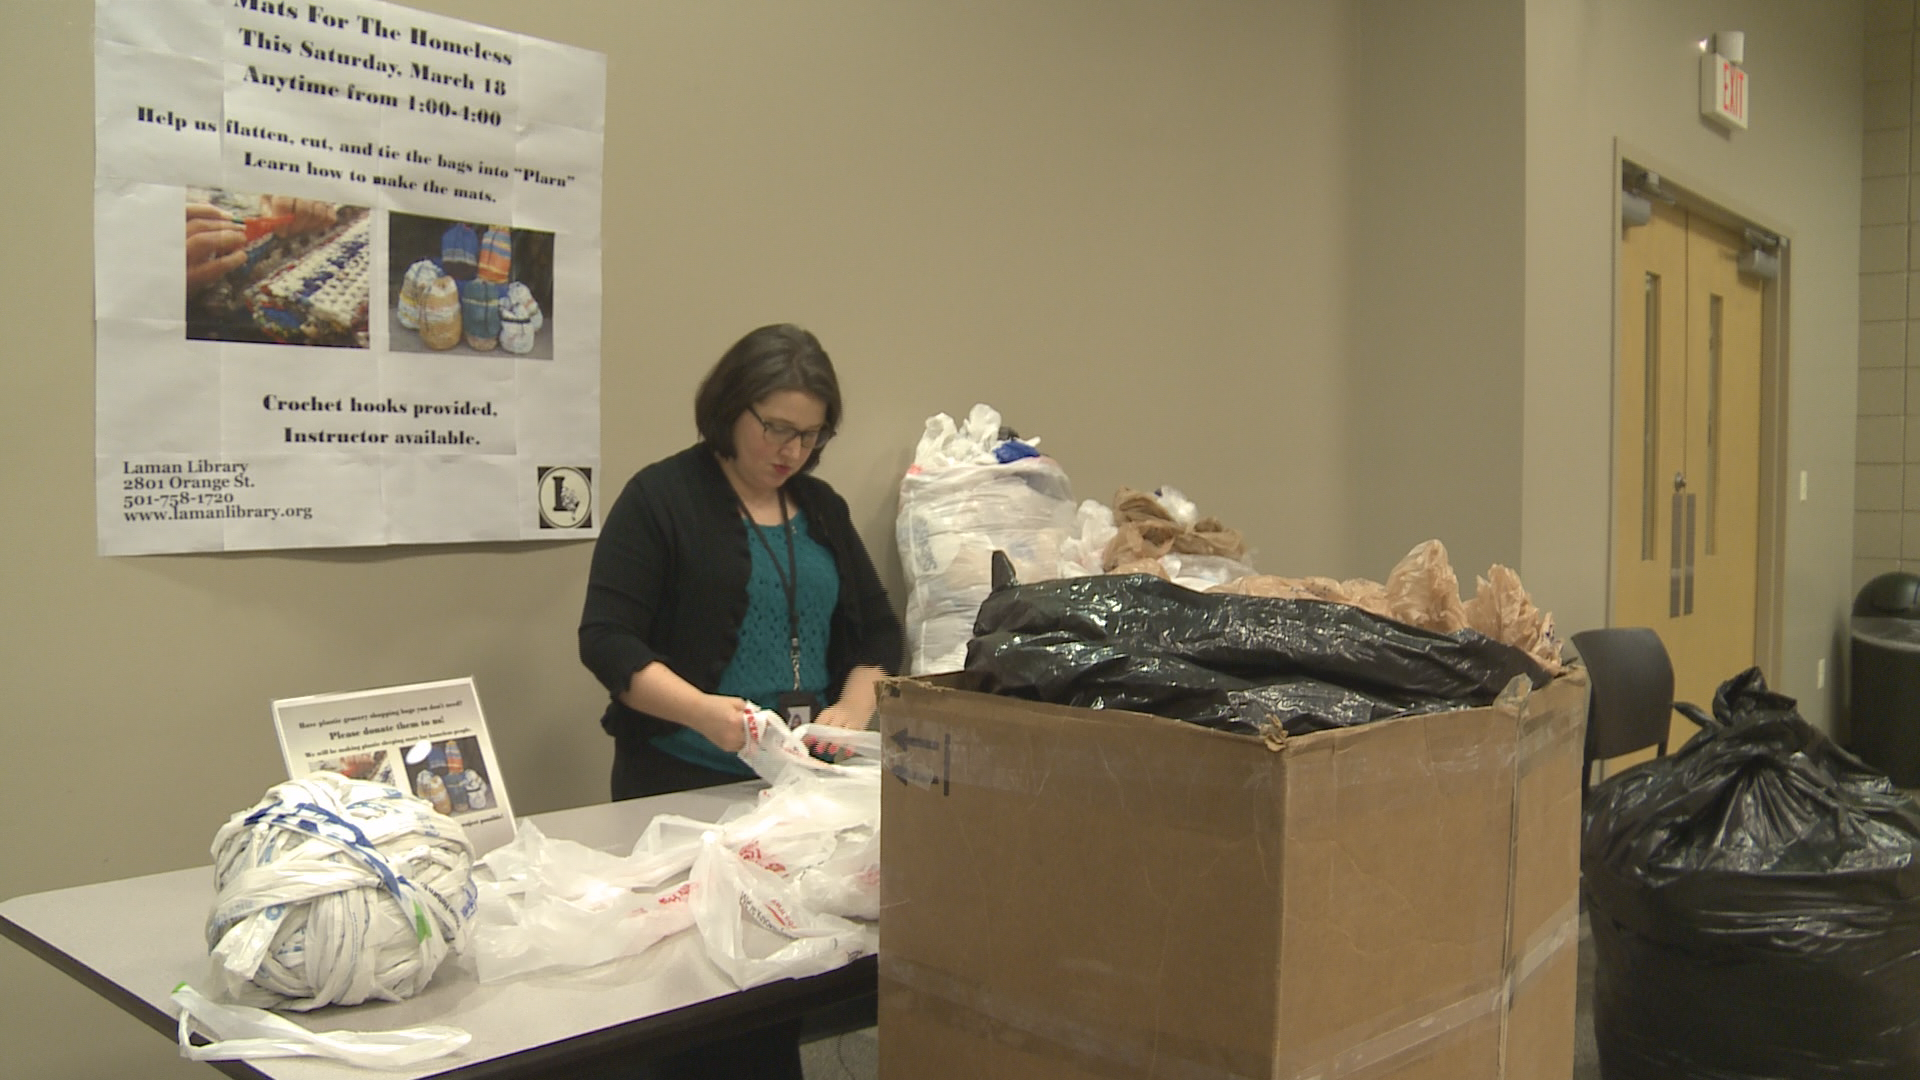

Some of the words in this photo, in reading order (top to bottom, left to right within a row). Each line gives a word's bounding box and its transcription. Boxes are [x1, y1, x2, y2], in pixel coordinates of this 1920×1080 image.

[308, 4, 349, 29] For
[357, 15, 401, 41] The
[410, 27, 512, 65] Homeless
[239, 27, 292, 54] This
[300, 40, 402, 78] Saturday,
[410, 62, 475, 90] March
[485, 78, 506, 96] 18
[243, 65, 339, 97] Anytime
[347, 83, 398, 107] from
[409, 94, 502, 127] 1:00-4:00
[1723, 62, 1744, 119] EXIT
[138, 106, 187, 131] Help
[195, 121, 217, 132] us
[226, 119, 294, 145] flatten,
[301, 137, 334, 151] cut,
[340, 142, 372, 156] and
[378, 145, 400, 160] tie
[406, 150, 432, 165] the
[438, 154, 473, 174] bags
[478, 161, 509, 178] into
[245, 152, 299, 173] Learn
[307, 161, 341, 179] how
[350, 170, 366, 182] to
[373, 175, 417, 190] make
[423, 180, 448, 195] the
[454, 187, 496, 203] mats.
[263, 394, 342, 411] Crochet
[351, 397, 407, 413] hooks
[284, 427, 388, 443] Instructor
[395, 430, 480, 445] available.
[123, 461, 182, 474] Laman
[187, 460, 248, 478] Library
[123, 477, 164, 490] 2801
[169, 476, 230, 491] Orange
[234, 475, 255, 488] St.
[123, 491, 234, 509] 501-758-1720
[124, 504, 313, 521] www.lamanlibrary.org
[329, 730, 361, 740] Please
[363, 725, 394, 735] donate
[396, 720, 419, 730] them
[421, 719, 430, 727] to
